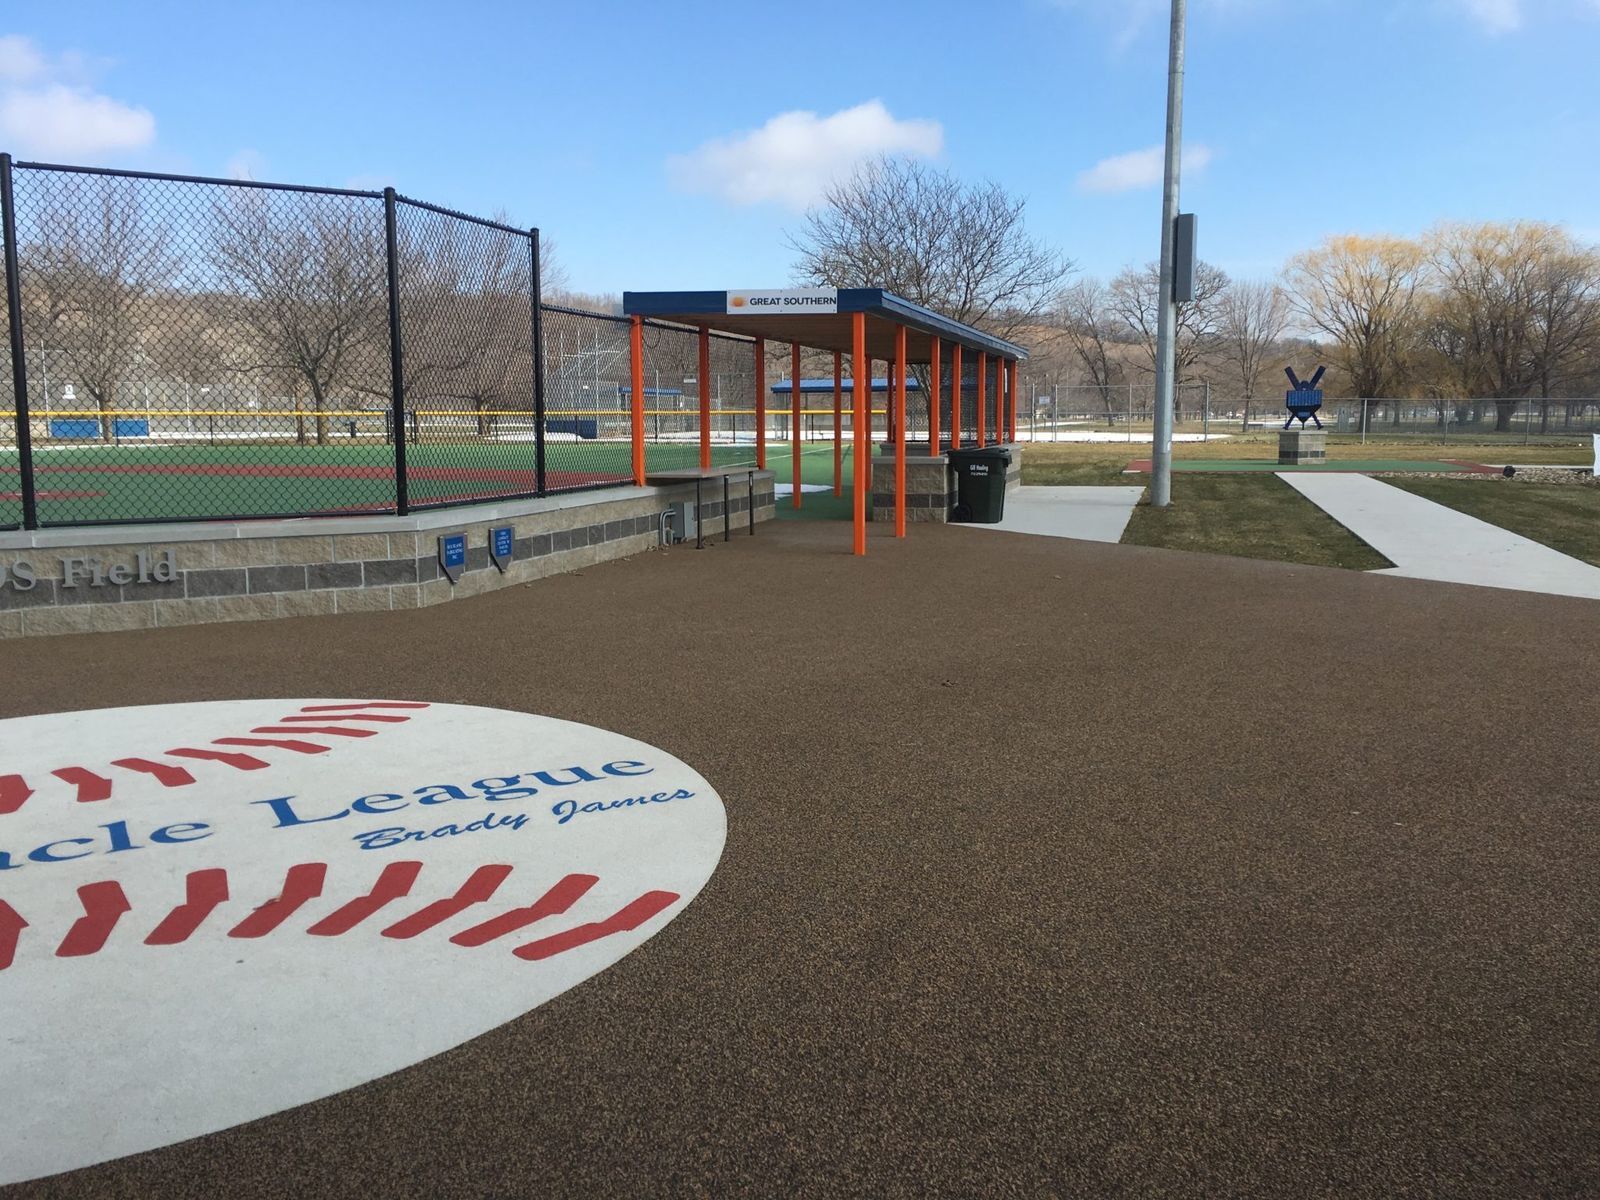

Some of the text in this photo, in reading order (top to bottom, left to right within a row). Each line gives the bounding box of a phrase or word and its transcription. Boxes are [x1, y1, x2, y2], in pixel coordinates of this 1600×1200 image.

[749, 296, 837, 306] GREAT SOUTHERN
[0, 549, 181, 591] S Field
[250, 760, 654, 829] League
[352, 788, 696, 850] Brady James
